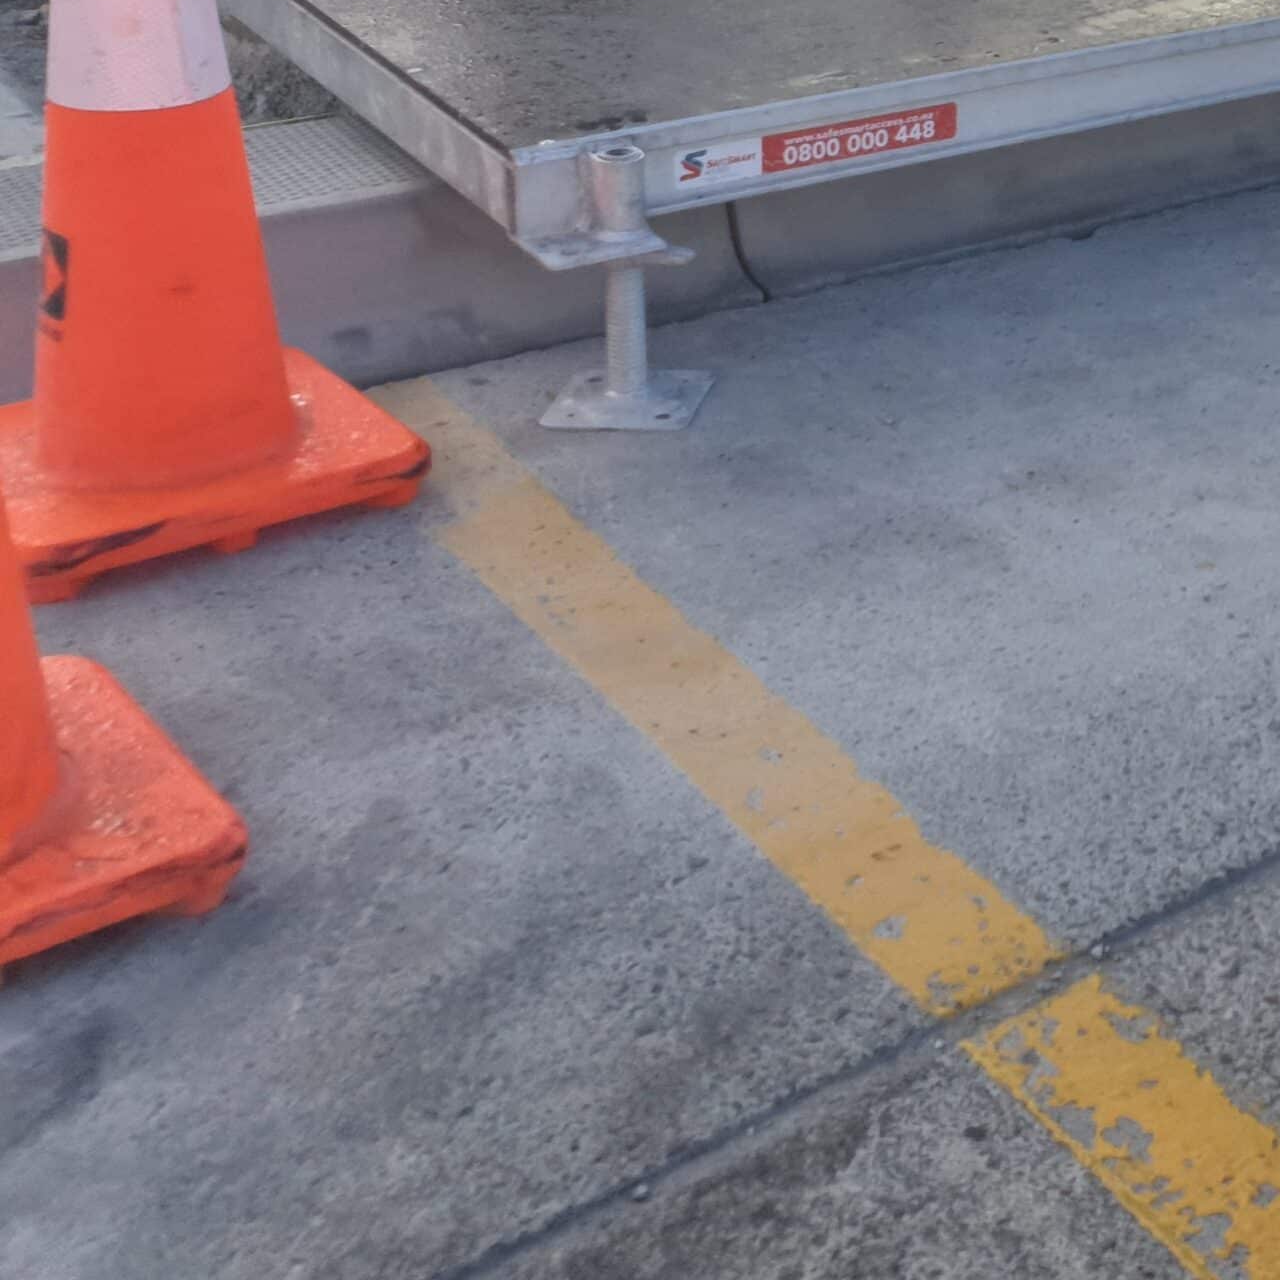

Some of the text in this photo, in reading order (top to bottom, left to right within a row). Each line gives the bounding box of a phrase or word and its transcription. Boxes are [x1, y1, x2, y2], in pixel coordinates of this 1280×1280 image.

[783, 120, 936, 165] 0800 000 448
